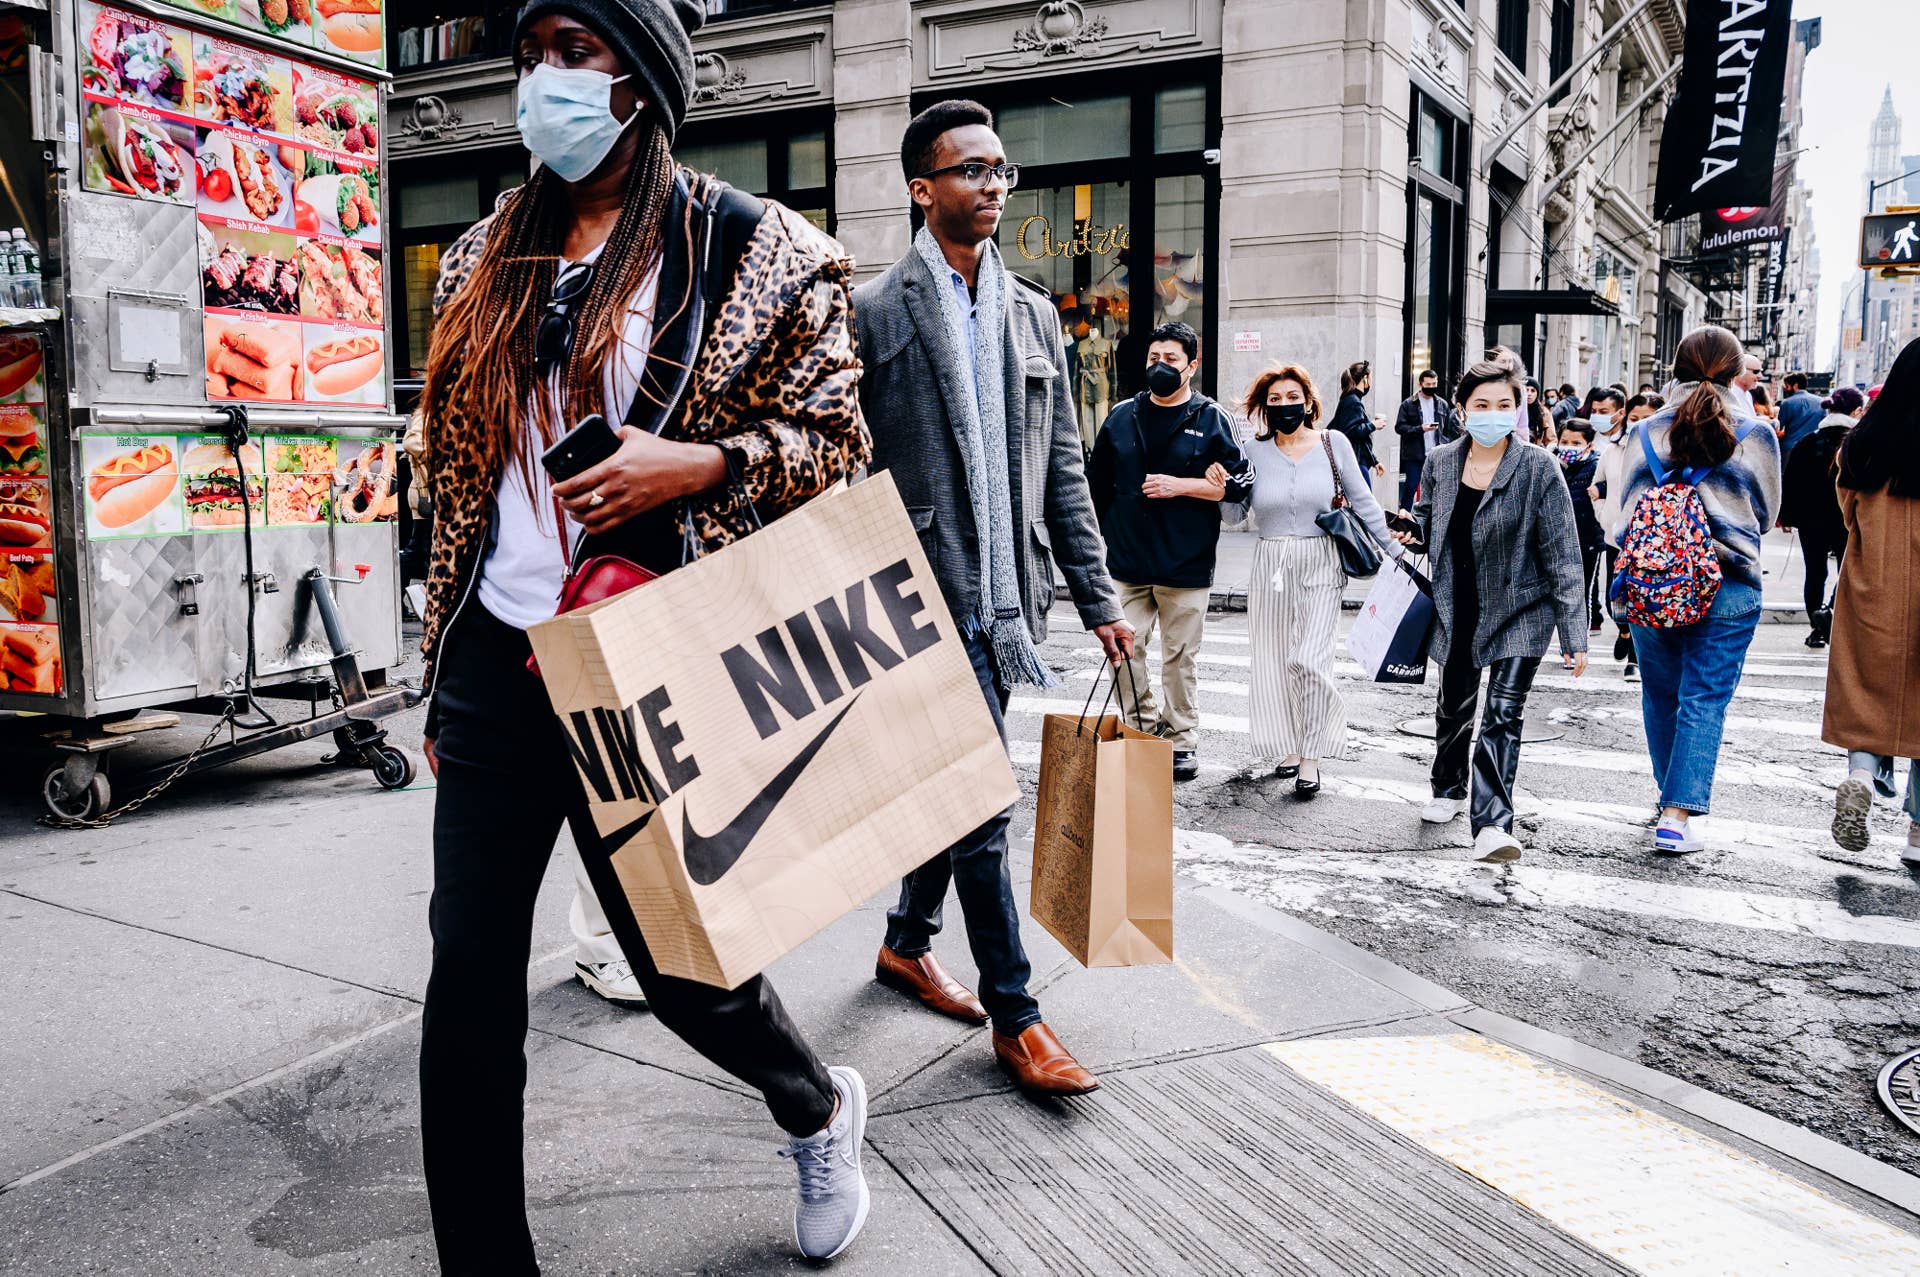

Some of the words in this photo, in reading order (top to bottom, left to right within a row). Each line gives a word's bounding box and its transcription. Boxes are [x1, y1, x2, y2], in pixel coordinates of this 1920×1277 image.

[105, 7, 128, 22] Lamb
[129, 16, 147, 27] over
[149, 20, 167, 33] Rice
[1691, 0, 1768, 192] ARITZIA
[117, 103, 140, 117] Lamb
[141, 108, 161, 122] Gyro
[222, 127, 252, 143] Chicken
[251, 134, 270, 148] Gyro
[334, 153, 363, 168] Sandwich
[226, 219, 247, 231] Shish
[248, 225, 270, 235] Kebab
[317, 234, 343, 247] Chicken
[343, 238, 363, 250] Kebab
[1702, 225, 1779, 250] lululemon
[117, 437, 132, 447] Hot
[132, 437, 149, 448] Dog
[9, 553, 21, 562] Beef
[21, 554, 35, 564] Patty
[720, 558, 942, 740] NIKE
[558, 684, 702, 806] NIKE
